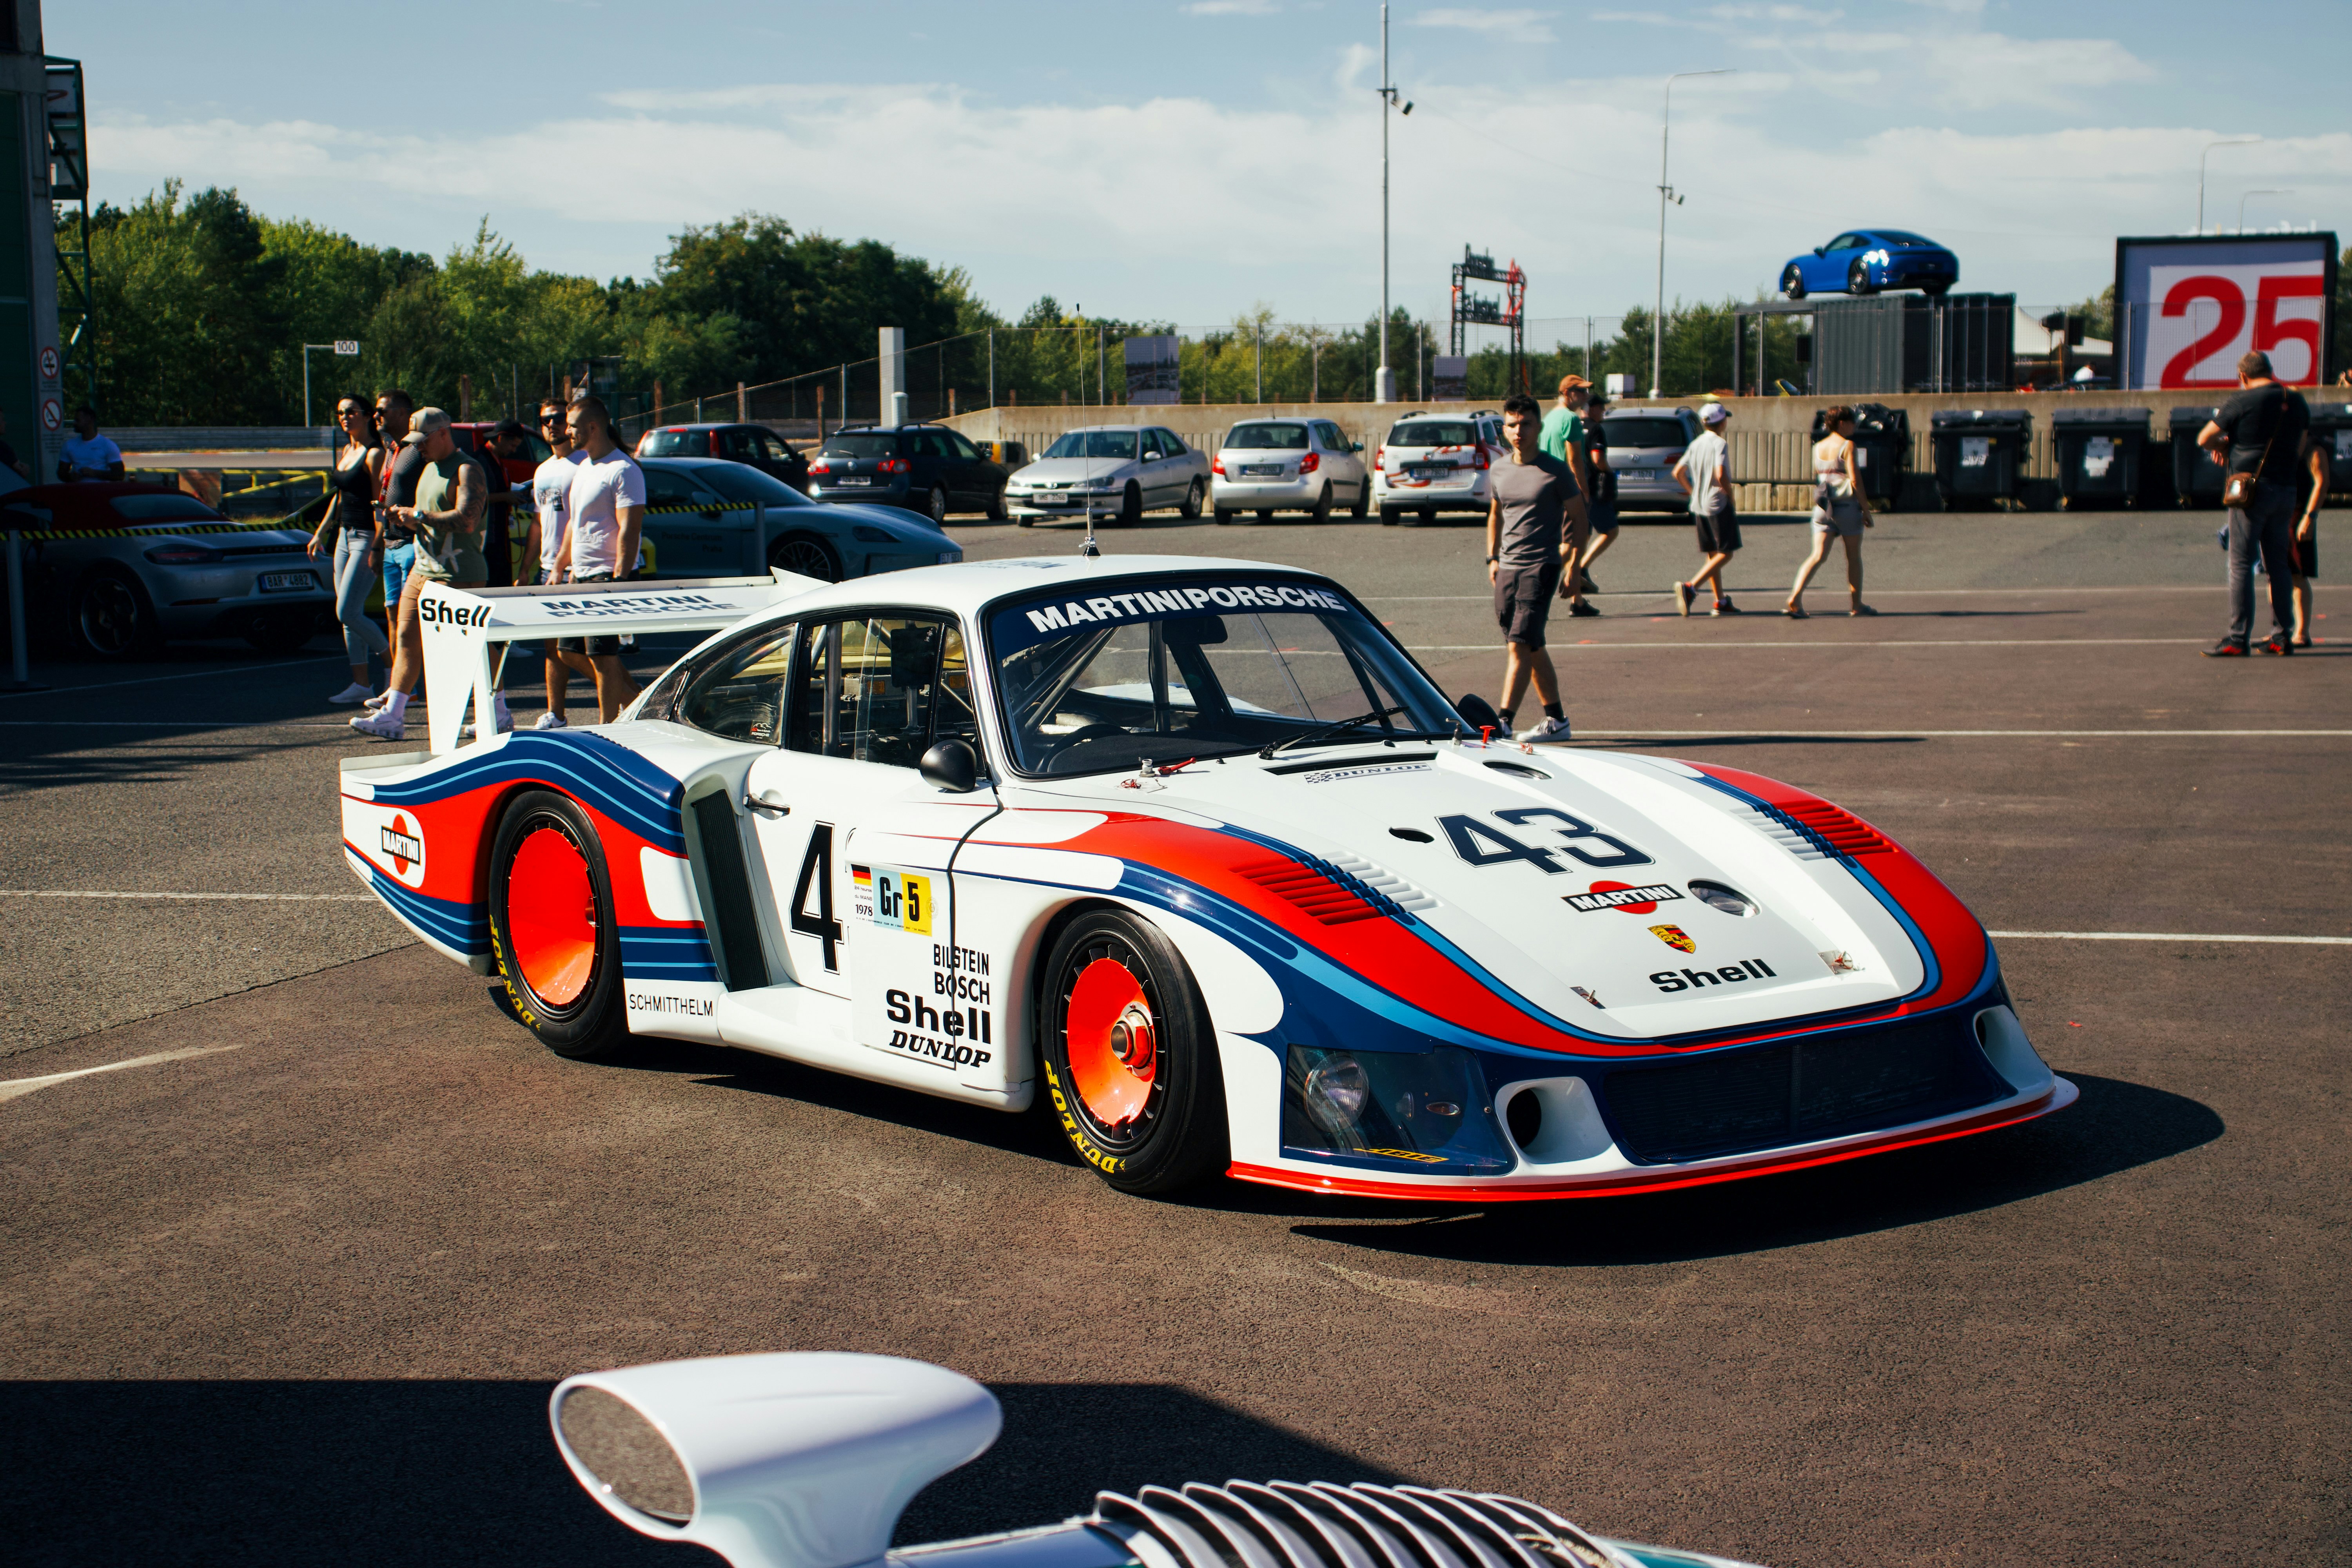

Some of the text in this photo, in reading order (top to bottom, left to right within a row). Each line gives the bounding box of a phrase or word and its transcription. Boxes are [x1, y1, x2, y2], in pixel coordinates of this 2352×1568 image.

[338, 341, 355, 351] 100
[2161, 275, 2324, 390] 25
[661, 531, 722, 541] Porsche Centrum
[702, 544, 722, 552] Praha
[267, 574, 309, 587] 8AR 4882
[421, 599, 492, 628] Shell
[541, 595, 714, 610] MARTINI
[546, 603, 744, 617] PORSCHE
[1334, 765, 1428, 777] DUNLOP
[382, 829, 419, 861] MARTINI
[1434, 806, 1656, 876] 43
[789, 820, 840, 975] 4
[855, 904, 873, 916] 1978
[879, 877, 903, 918] Gr
[907, 881, 920, 922] 5
[1569, 886, 1679, 909] MARTINI
[490, 914, 536, 1026] DUNLOP
[934, 943, 989, 976] BILSTEIN
[1649, 958, 1778, 993] Shell
[935, 971, 990, 1005] BOSCH
[629, 994, 713, 1016] SCHMITTHELM
[886, 989, 991, 1045] Shell
[889, 1029, 991, 1068] DUNLOP
[1045, 1060, 1118, 1174] DUNLOP
